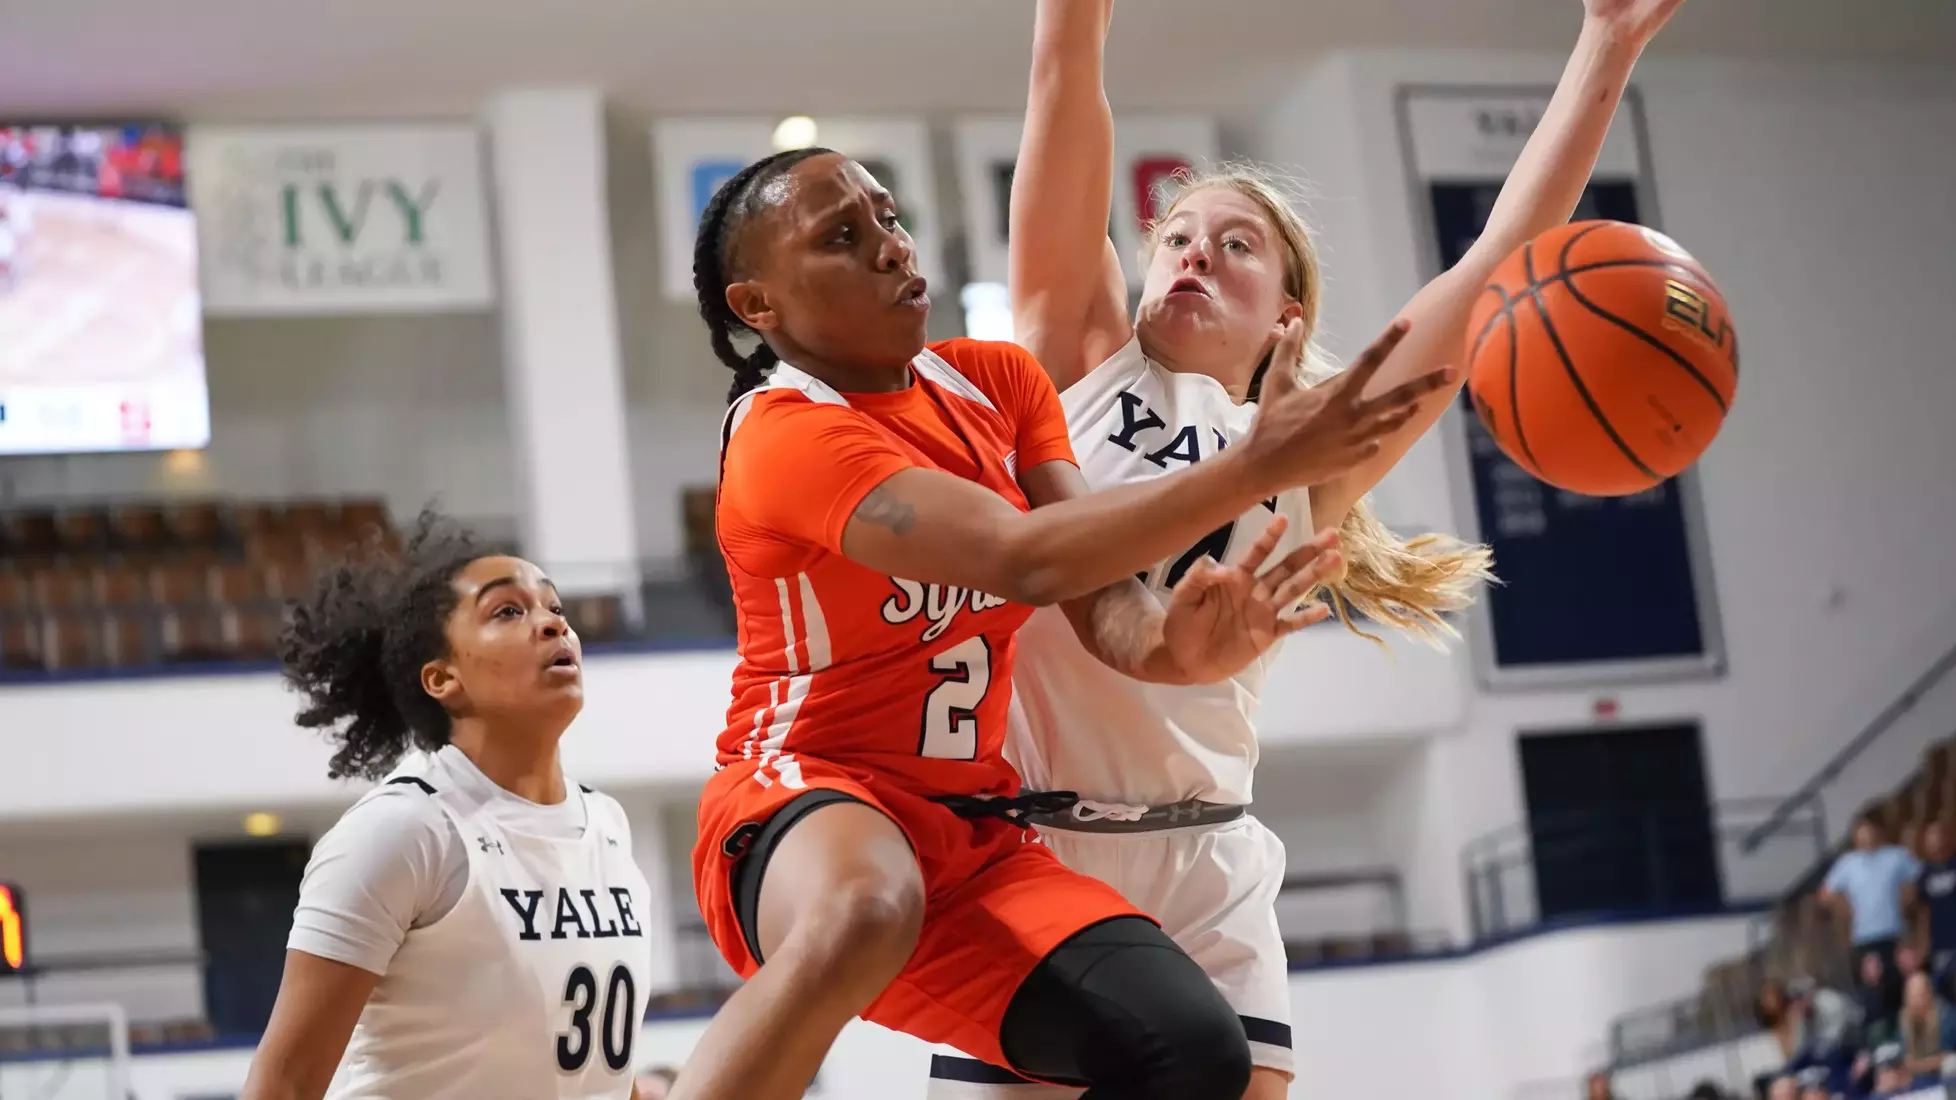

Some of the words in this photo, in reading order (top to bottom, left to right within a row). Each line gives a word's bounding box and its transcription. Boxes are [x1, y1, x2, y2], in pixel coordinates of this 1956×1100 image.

[280, 178, 444, 248] IVY
[916, 632, 992, 762] 2
[500, 887, 643, 941] YALE
[555, 960, 636, 1077] 30
